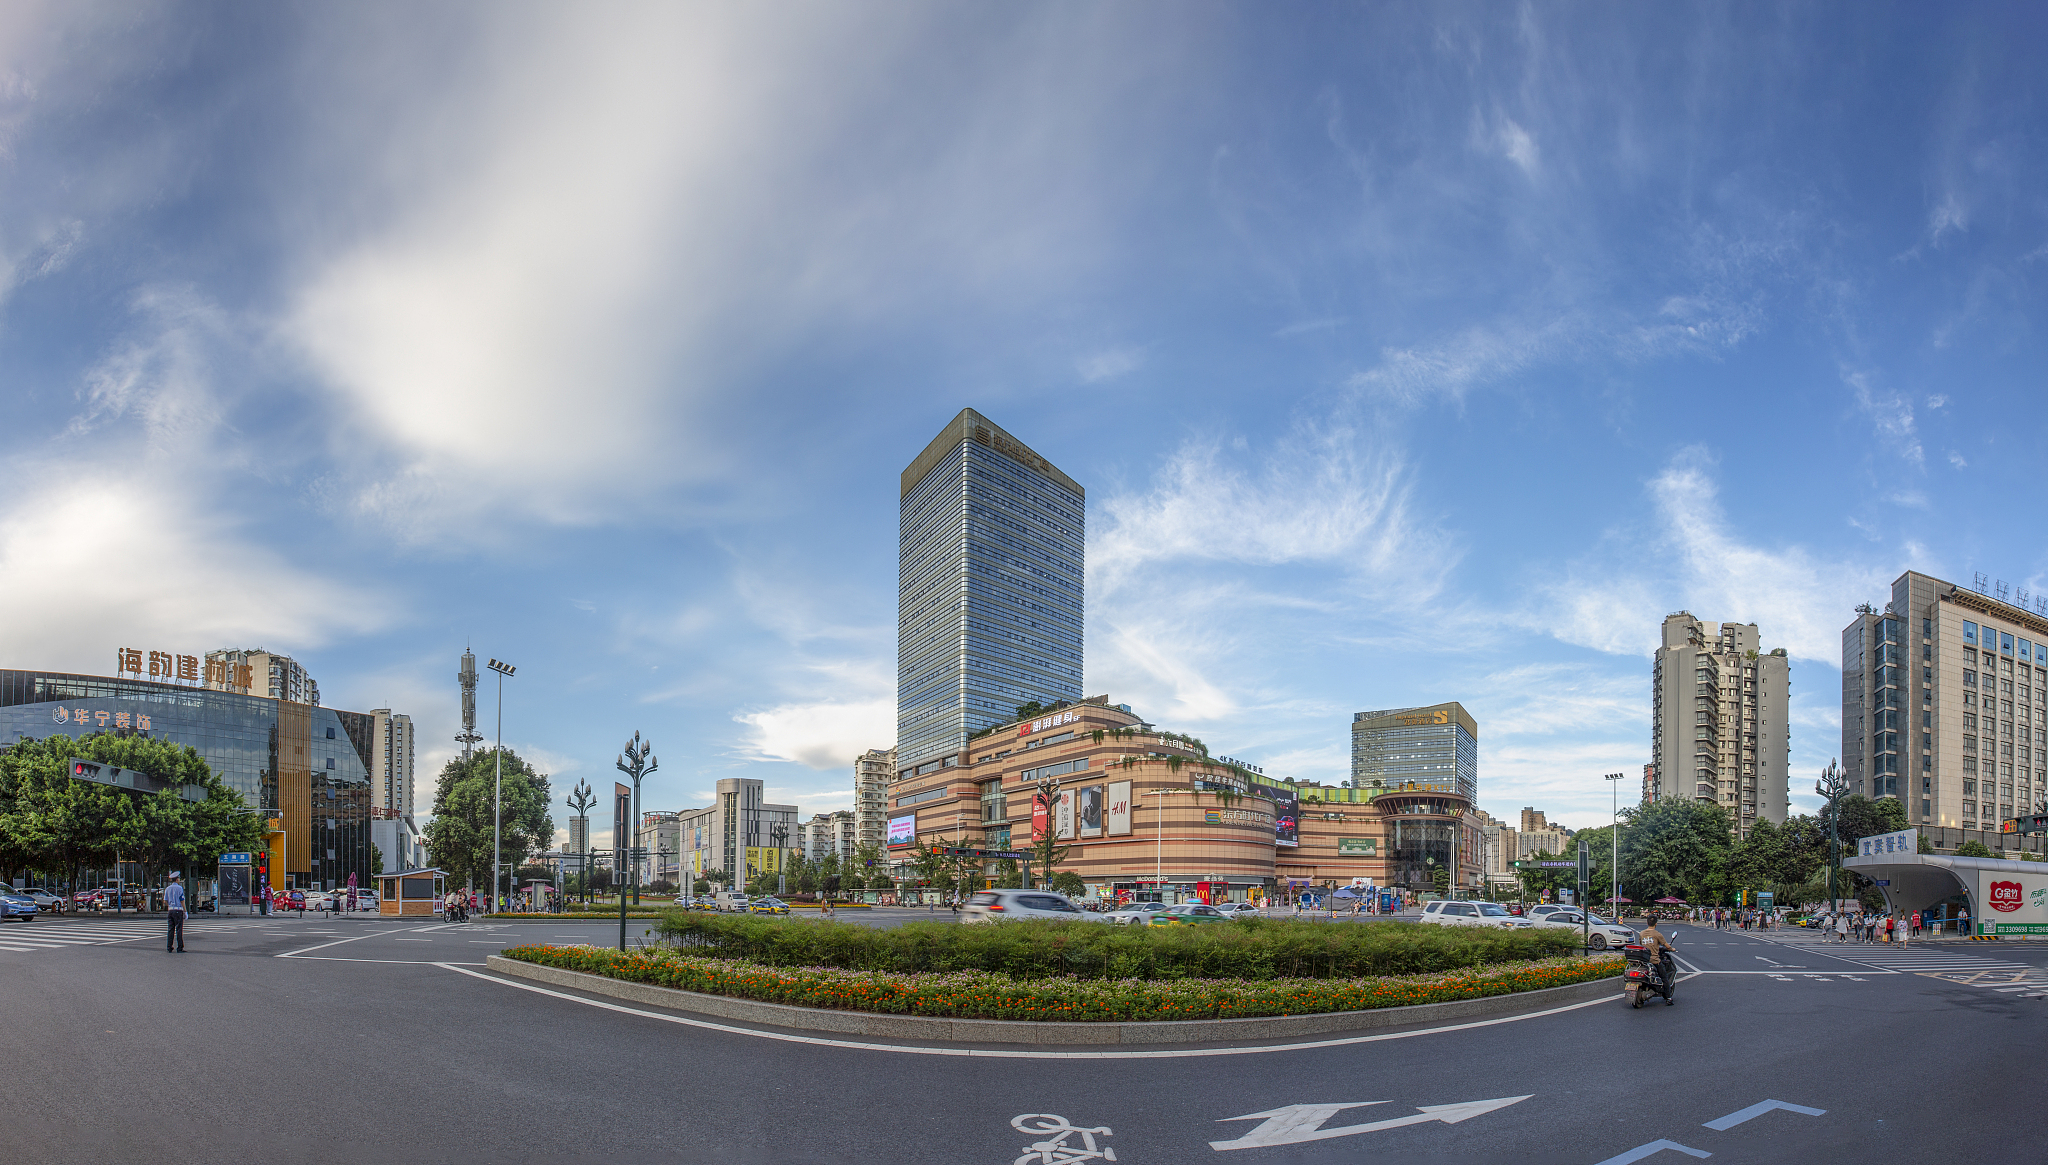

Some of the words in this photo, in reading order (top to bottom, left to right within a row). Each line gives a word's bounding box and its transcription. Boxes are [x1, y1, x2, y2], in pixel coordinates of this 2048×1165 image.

[117, 647, 253, 689] 海韵建材城
[74, 708, 151, 730] 华宁装饰
[1222, 809, 1271, 824] 东方时代广场
[1863, 832, 1908, 856] 宜宾智轨
